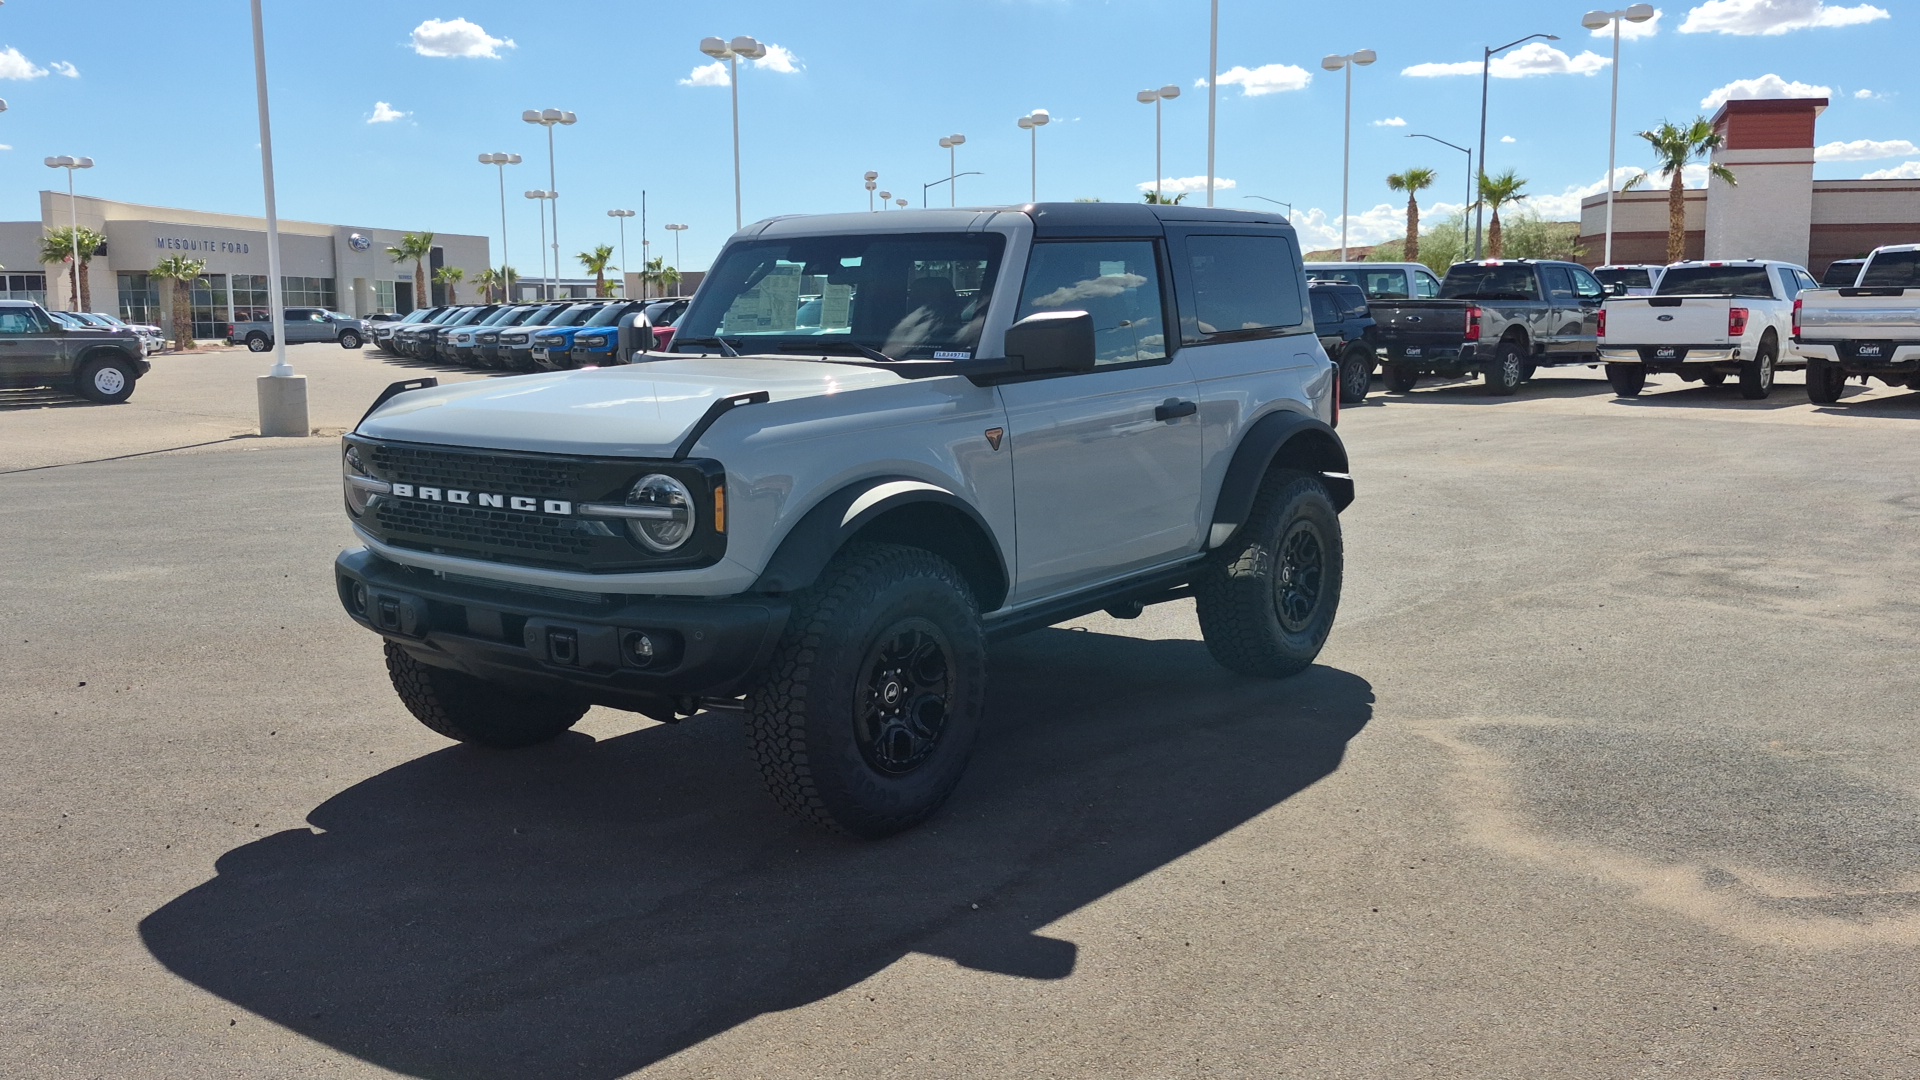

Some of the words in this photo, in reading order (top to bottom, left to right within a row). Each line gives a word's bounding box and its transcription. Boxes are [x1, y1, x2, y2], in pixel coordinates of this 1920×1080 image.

[157, 238, 216, 252] MESQUITE
[221, 242, 249, 254] FORD
[1859, 346, 1880, 354] Garff
[392, 483, 572, 515] BRONCO
